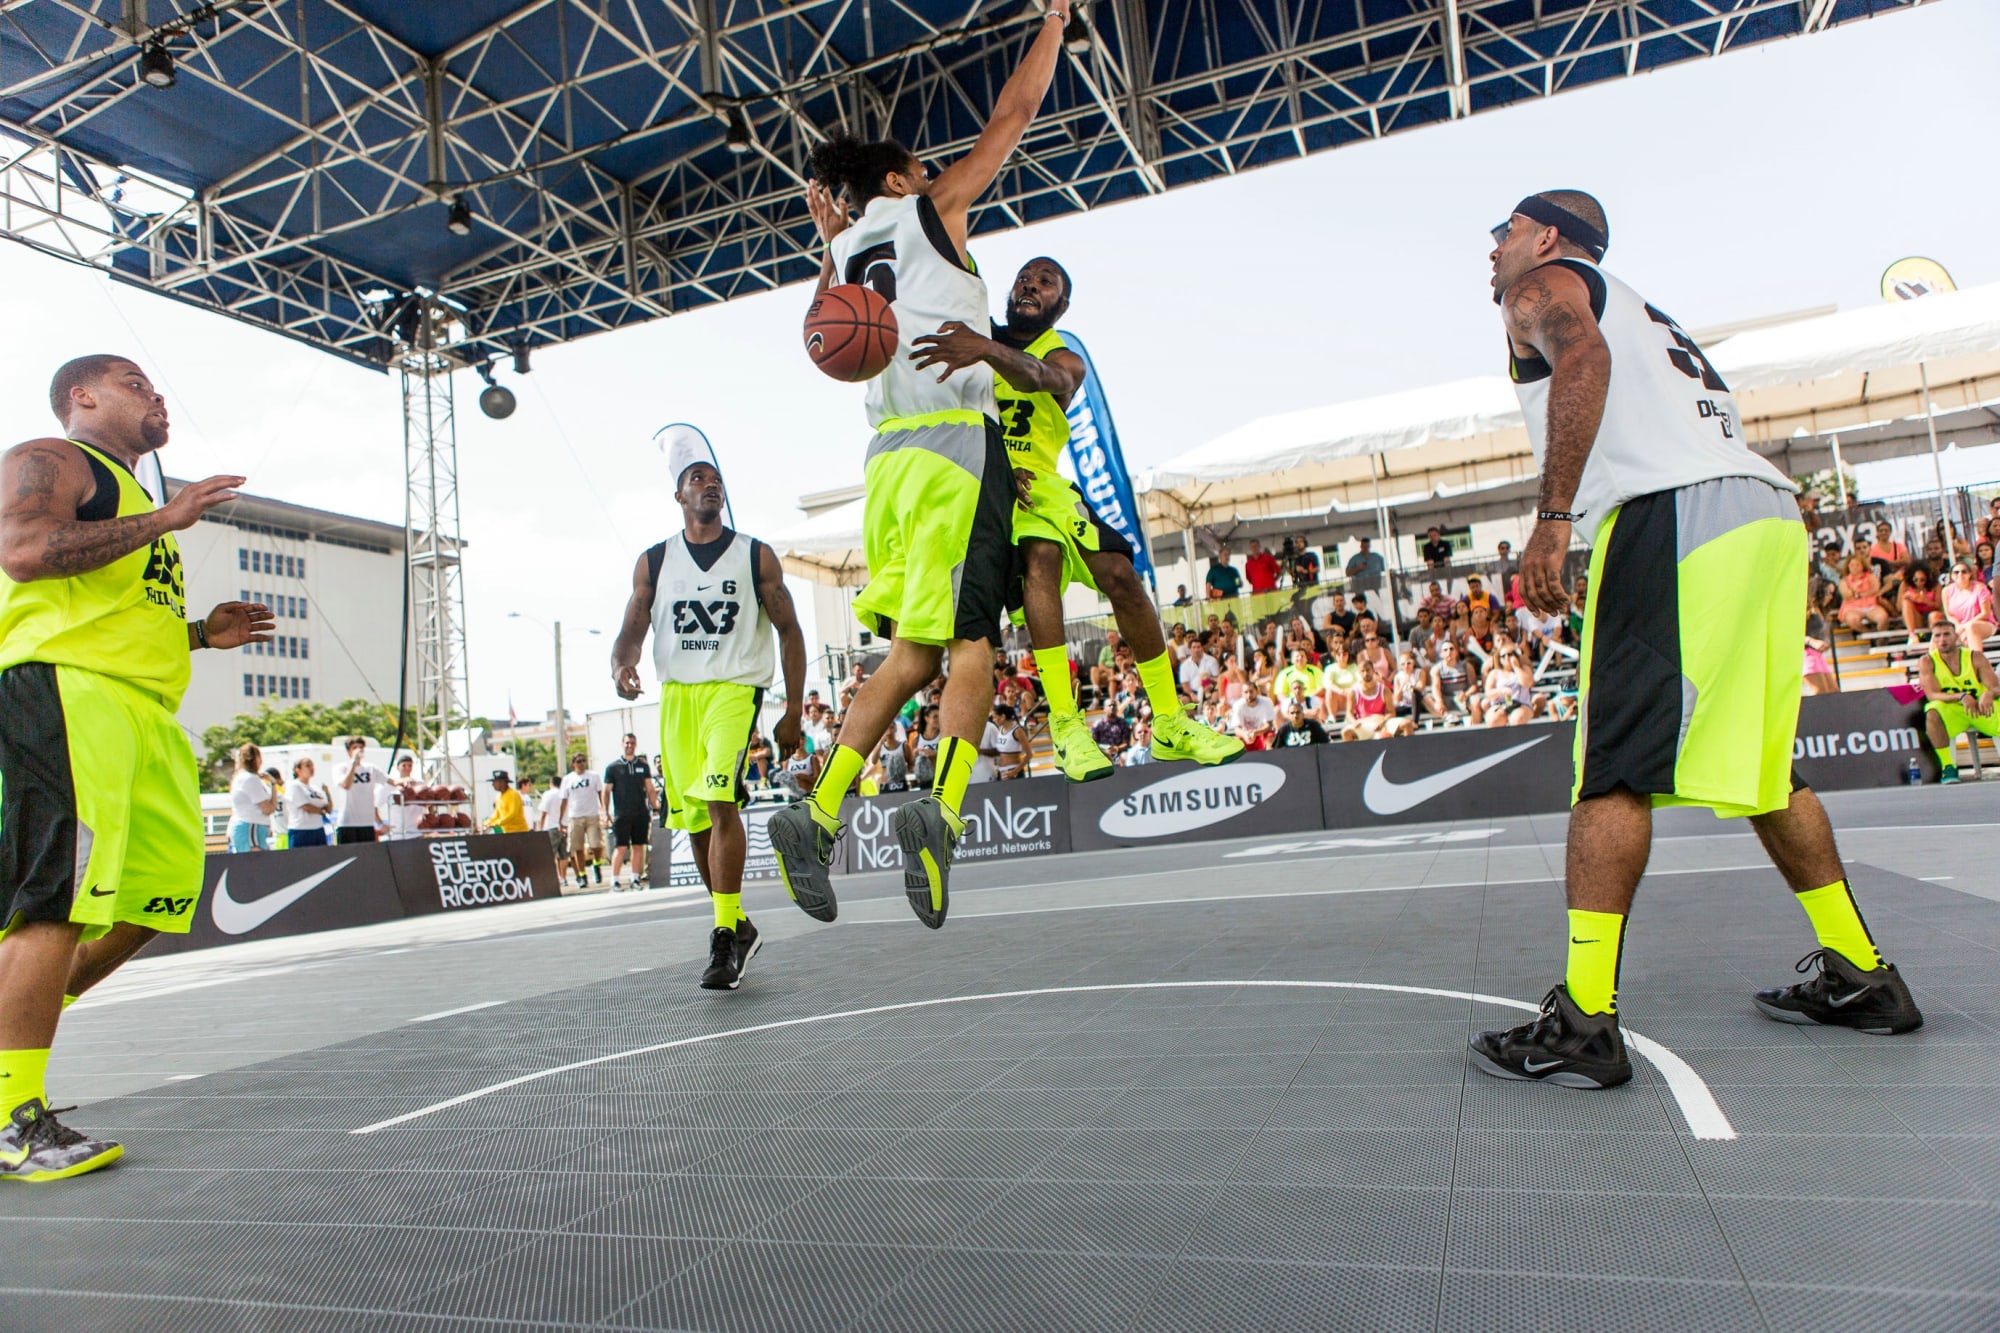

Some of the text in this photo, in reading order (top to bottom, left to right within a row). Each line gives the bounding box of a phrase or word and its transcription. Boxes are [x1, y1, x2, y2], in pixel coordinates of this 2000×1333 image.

[722, 580, 737, 595] 6
[681, 639, 720, 651] DENVER
[1123, 783, 1263, 818] SAMSUNG
[429, 841, 471, 864] SEE
[1002, 839, 1052, 854] Networks
[434, 858, 515, 885] PUERTO
[440, 877, 534, 908] RICO.COM
